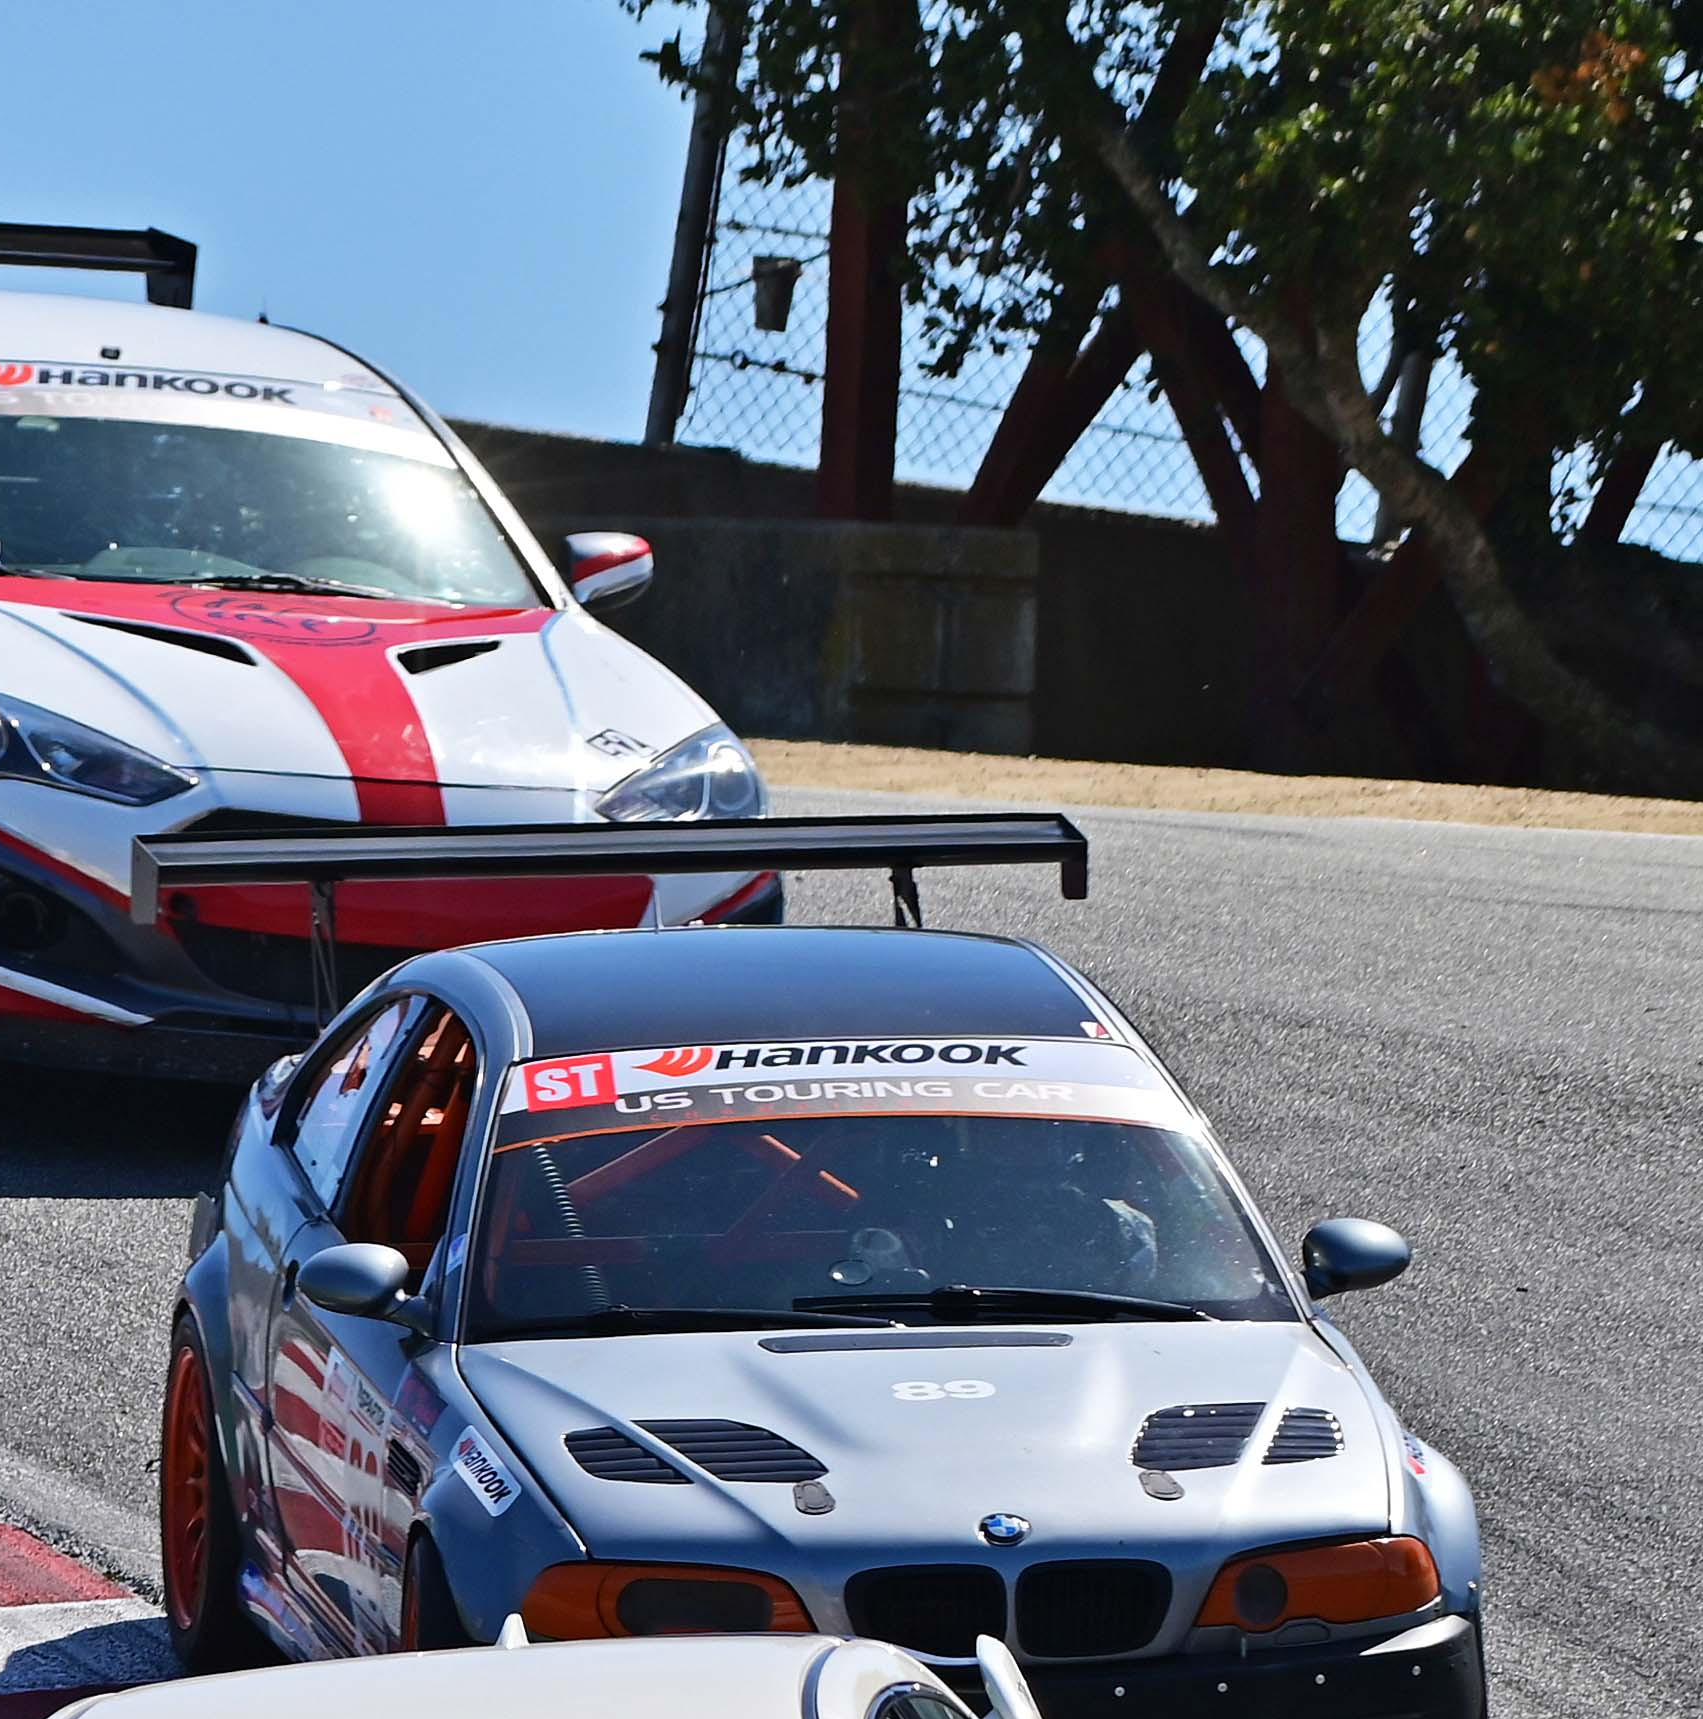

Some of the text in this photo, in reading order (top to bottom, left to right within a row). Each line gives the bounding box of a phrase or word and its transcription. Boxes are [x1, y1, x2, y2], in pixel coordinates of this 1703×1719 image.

[534, 1063, 604, 1102] ST
[615, 1080, 1074, 1114] US TOURING CAR
[891, 1379, 996, 1401] 89
